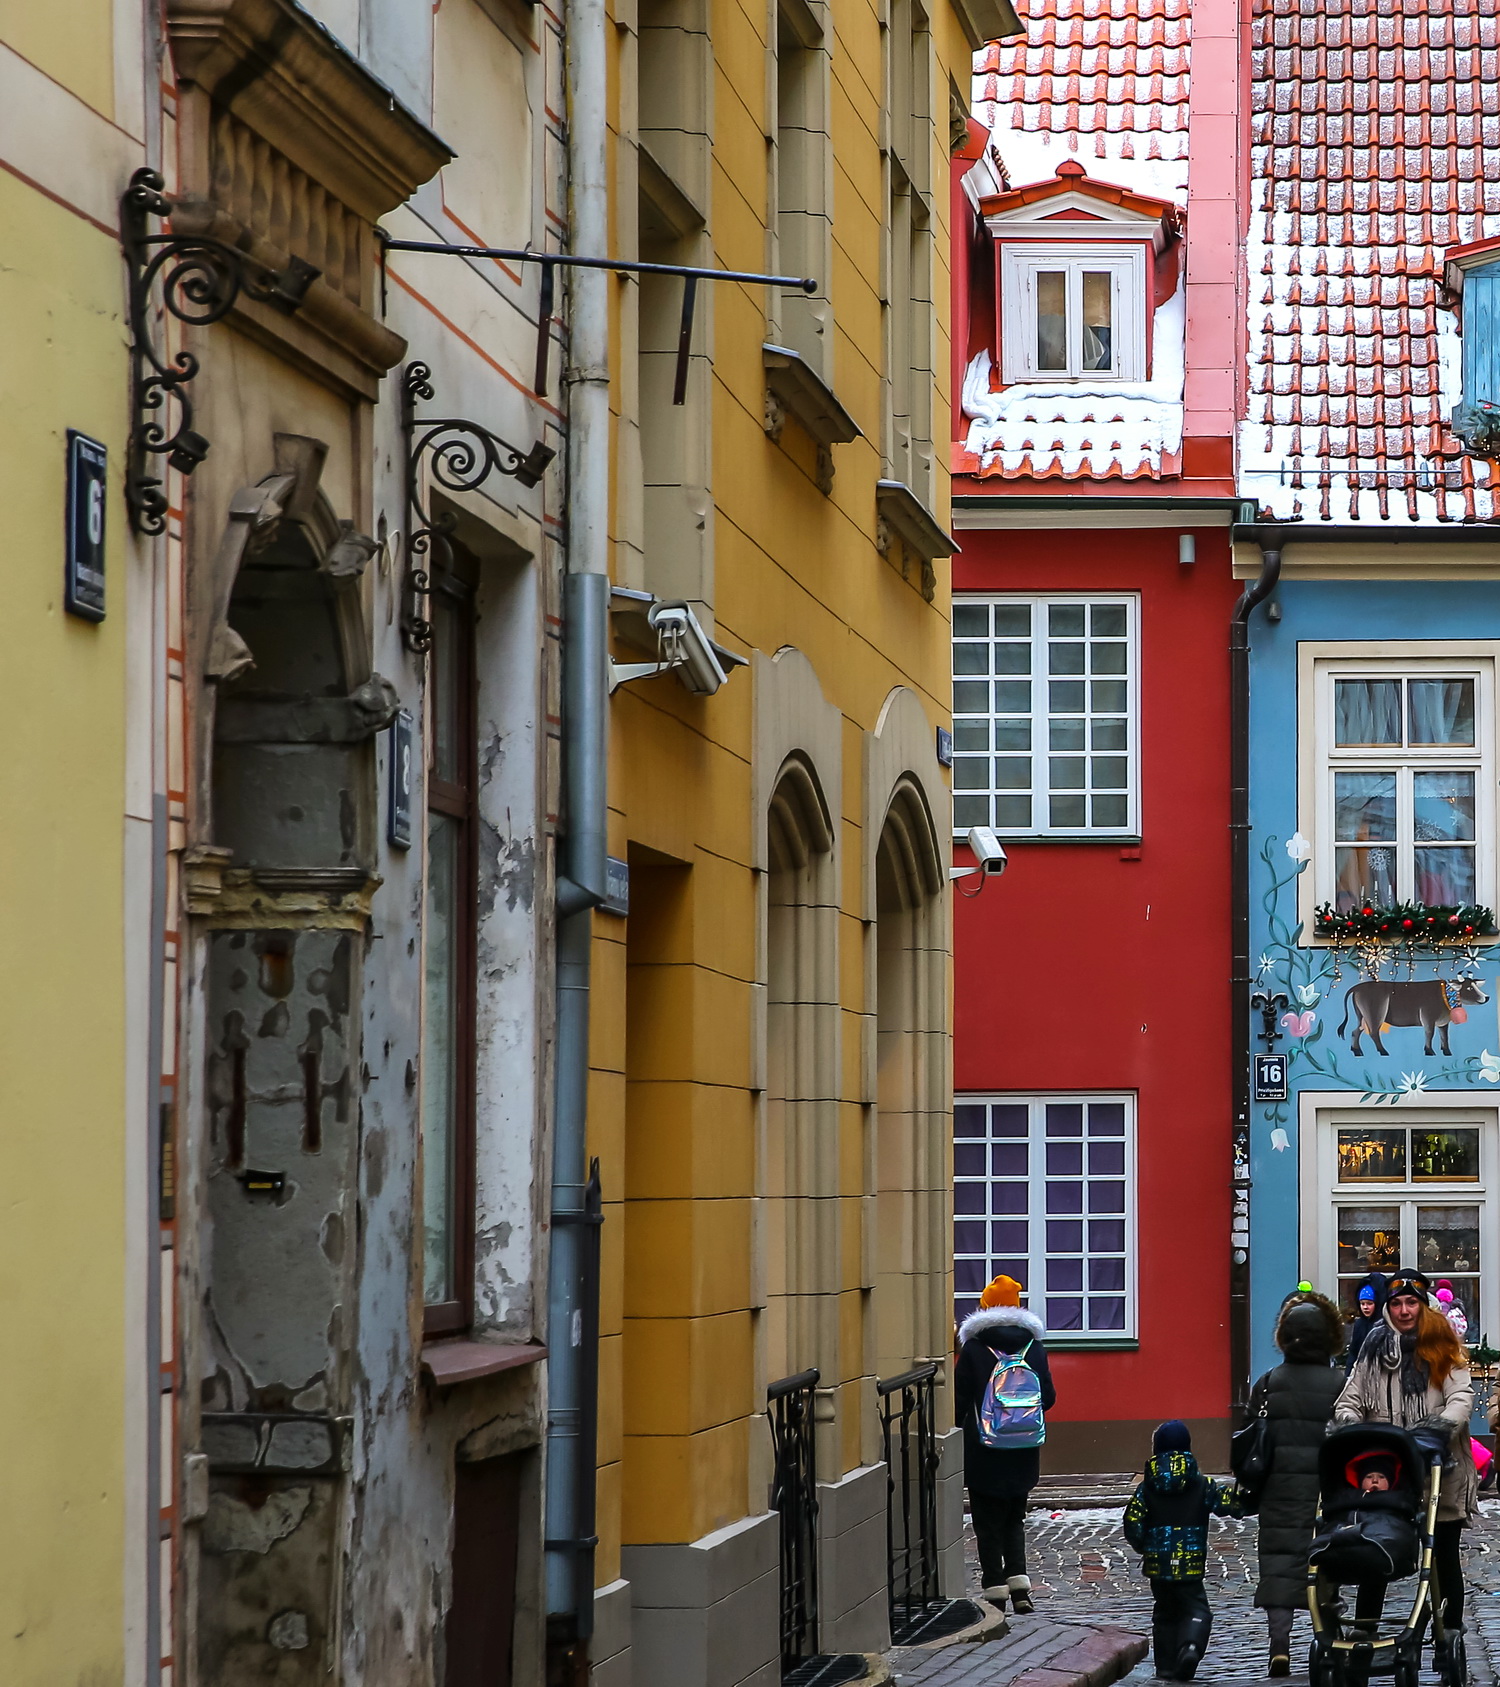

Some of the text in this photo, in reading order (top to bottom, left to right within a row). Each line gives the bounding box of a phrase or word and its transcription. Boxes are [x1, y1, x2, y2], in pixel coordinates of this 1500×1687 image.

[87, 478, 102, 545] 6
[402, 744, 412, 796] 8
[1260, 1064, 1282, 1083] 16
